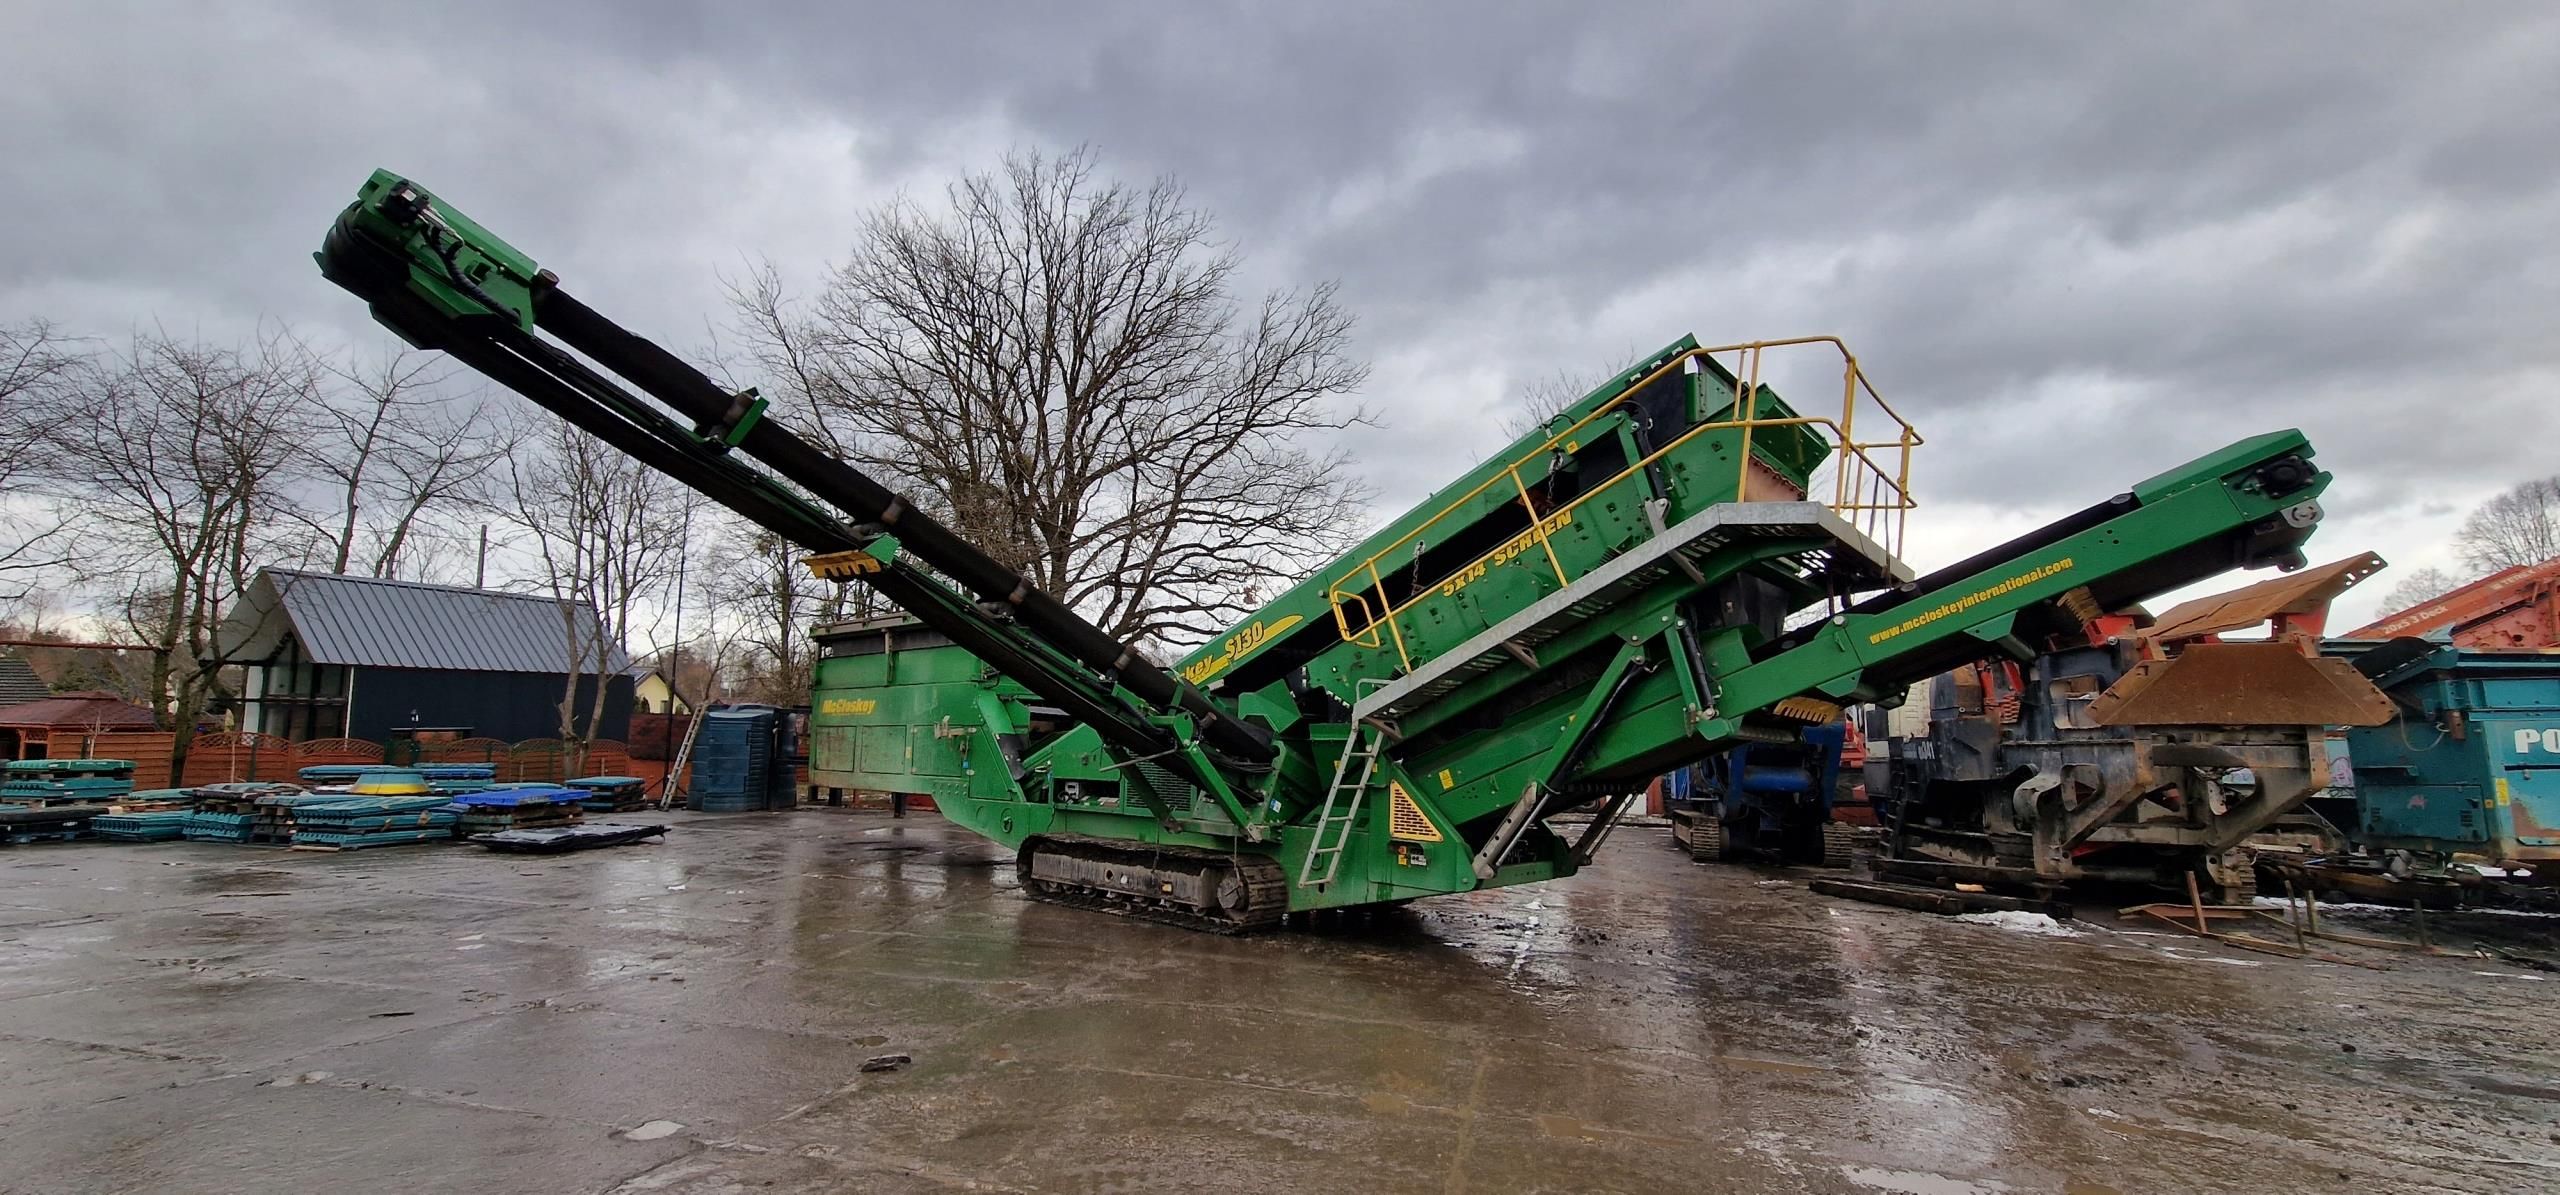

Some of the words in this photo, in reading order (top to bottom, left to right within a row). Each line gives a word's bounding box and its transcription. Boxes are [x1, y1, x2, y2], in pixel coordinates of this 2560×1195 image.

[1442, 562, 1486, 597] 5x14
[1868, 556, 2073, 645] www.mccloskeyinternational.com
[2420, 605, 2448, 620] Deck
[1181, 654, 1214, 680] key
[1224, 621, 1264, 659] S130
[822, 698, 876, 715] McCloskey
